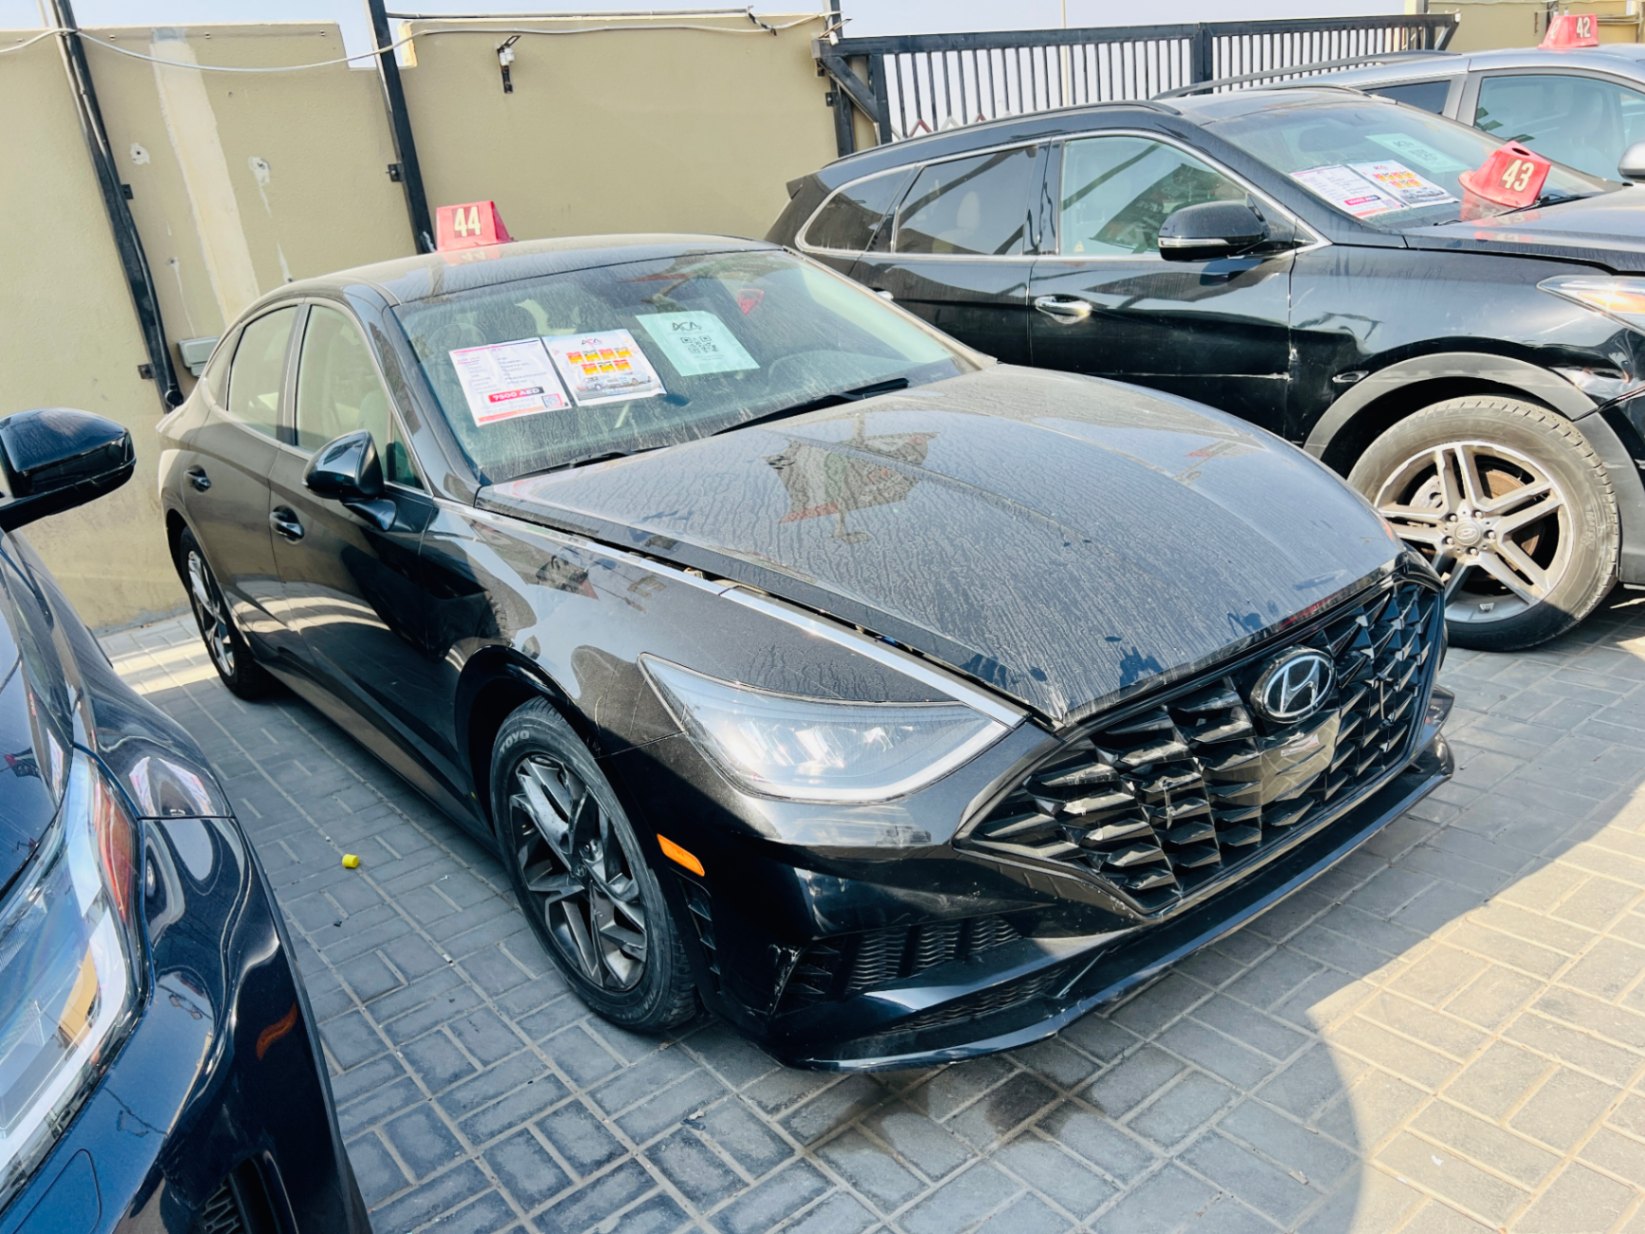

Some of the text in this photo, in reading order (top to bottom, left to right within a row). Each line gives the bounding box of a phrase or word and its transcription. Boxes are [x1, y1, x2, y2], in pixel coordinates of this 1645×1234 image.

[1576, 16, 1592, 38] 42
[1502, 159, 1535, 192] 43
[454, 206, 481, 237] 44
[500, 730, 530, 753] TOYO
